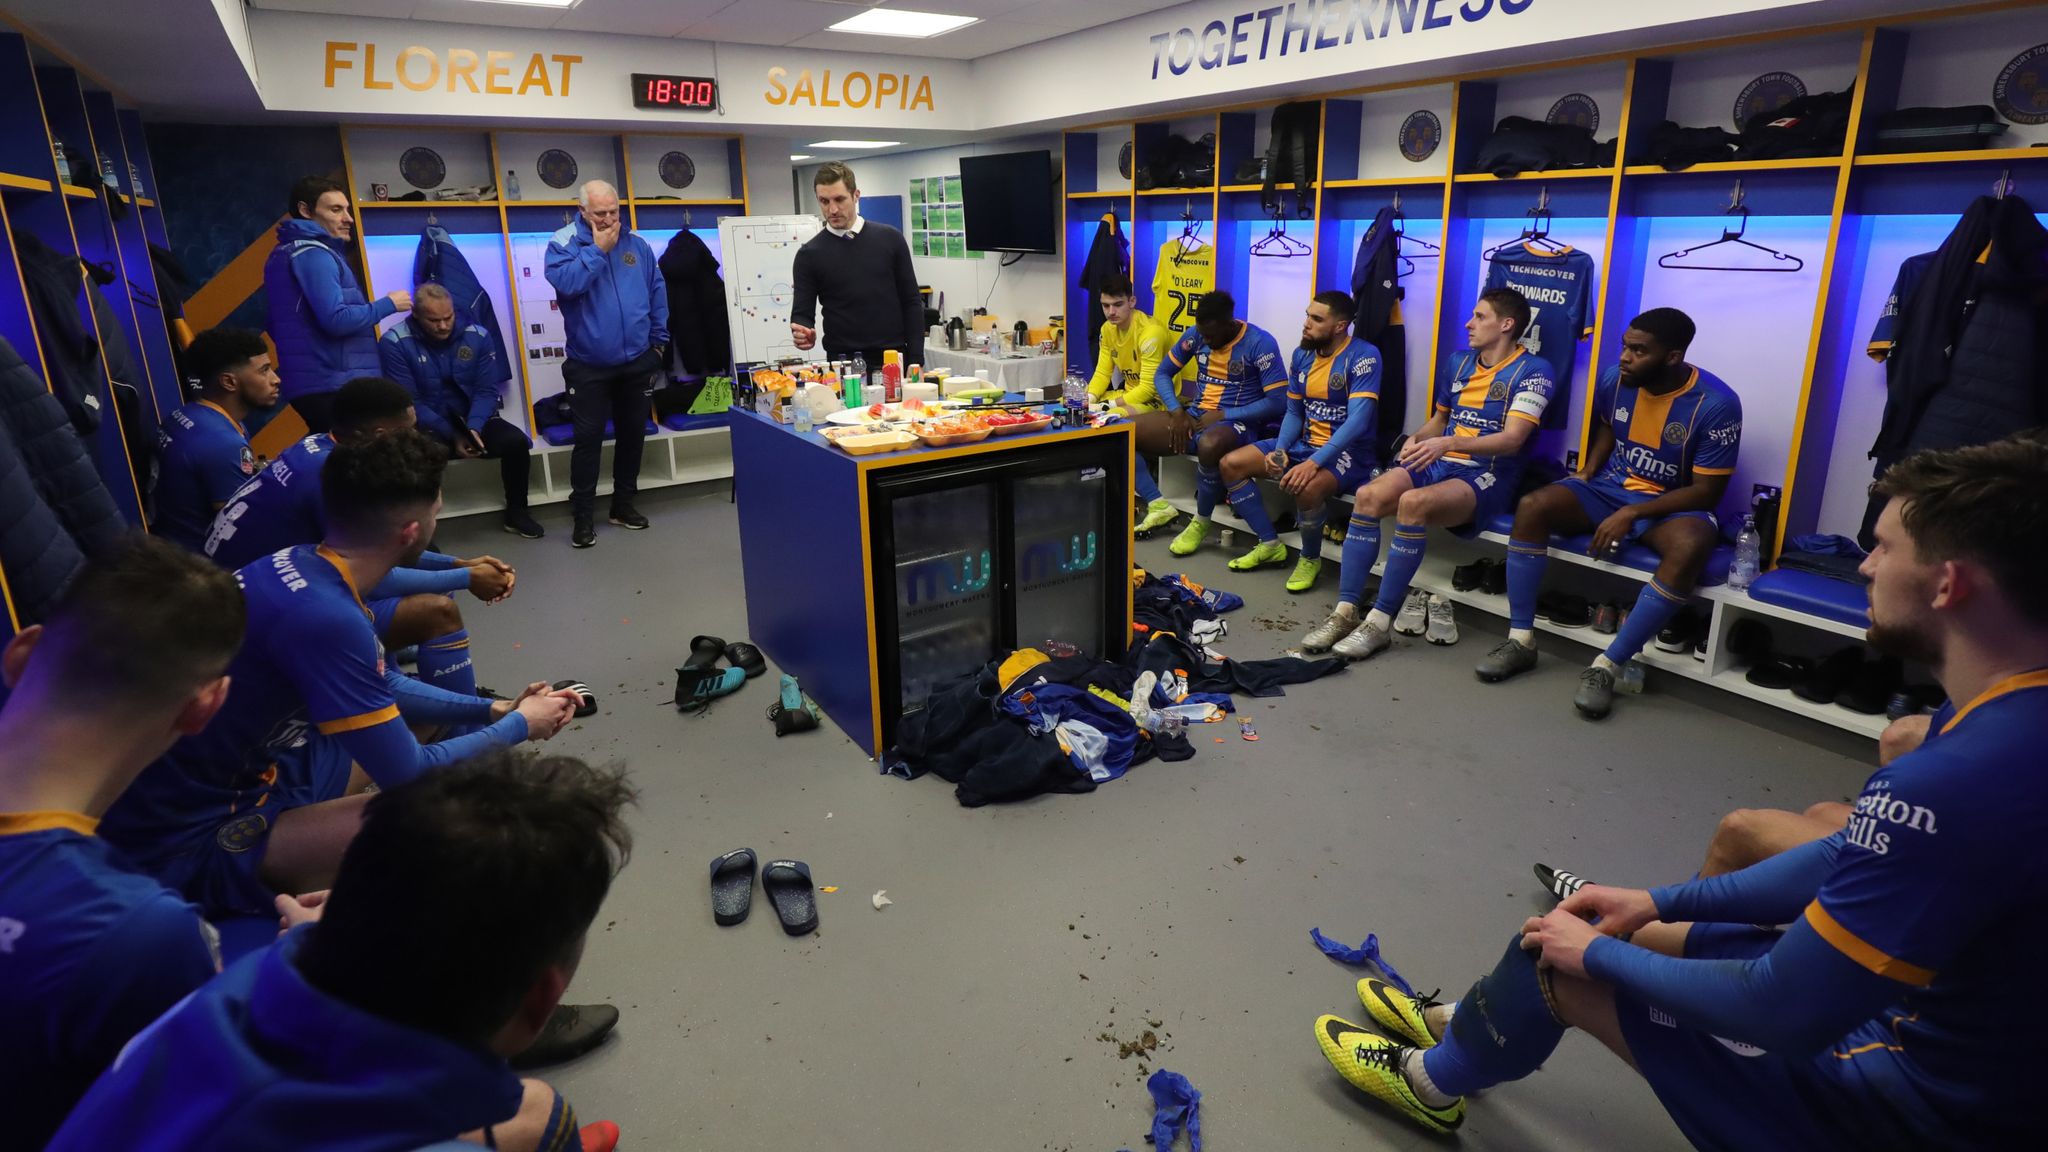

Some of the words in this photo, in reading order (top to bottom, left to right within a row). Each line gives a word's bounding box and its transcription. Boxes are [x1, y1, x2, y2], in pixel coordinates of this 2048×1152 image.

[324, 41, 583, 97] FLOREAT
[764, 66, 935, 111] SALOPIA
[648, 80, 712, 104] 18:00
[1509, 264, 1576, 281] TECHNOCOVER
[1615, 438, 1678, 477] Tuffins
